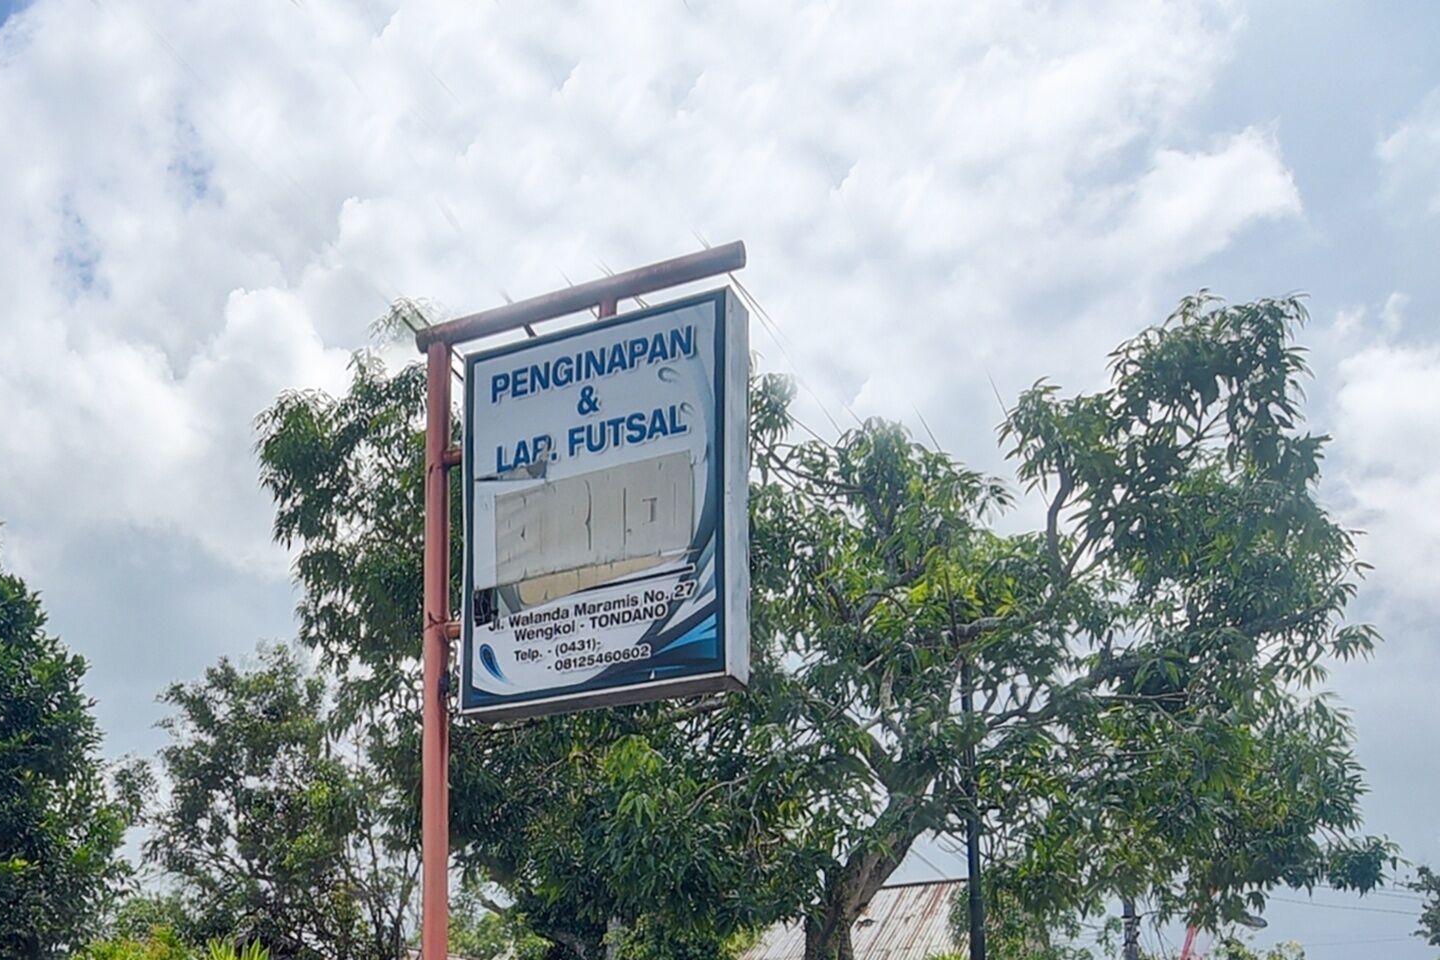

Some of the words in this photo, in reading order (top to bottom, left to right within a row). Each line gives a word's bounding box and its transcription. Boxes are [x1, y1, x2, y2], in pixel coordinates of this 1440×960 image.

[491, 325, 694, 403] PENGINAPAN
[577, 384, 601, 416] &
[496, 435, 558, 474] LAP.
[568, 405, 688, 457] FUTSAL
[509, 606, 570, 628] Walanda
[574, 594, 639, 617] Maramis
[644, 589, 669, 604] No.
[674, 582, 695, 598] 27
[514, 620, 576, 643] Wengkol
[589, 603, 667, 629] TONDANO
[514, 649, 542, 663] Telp.
